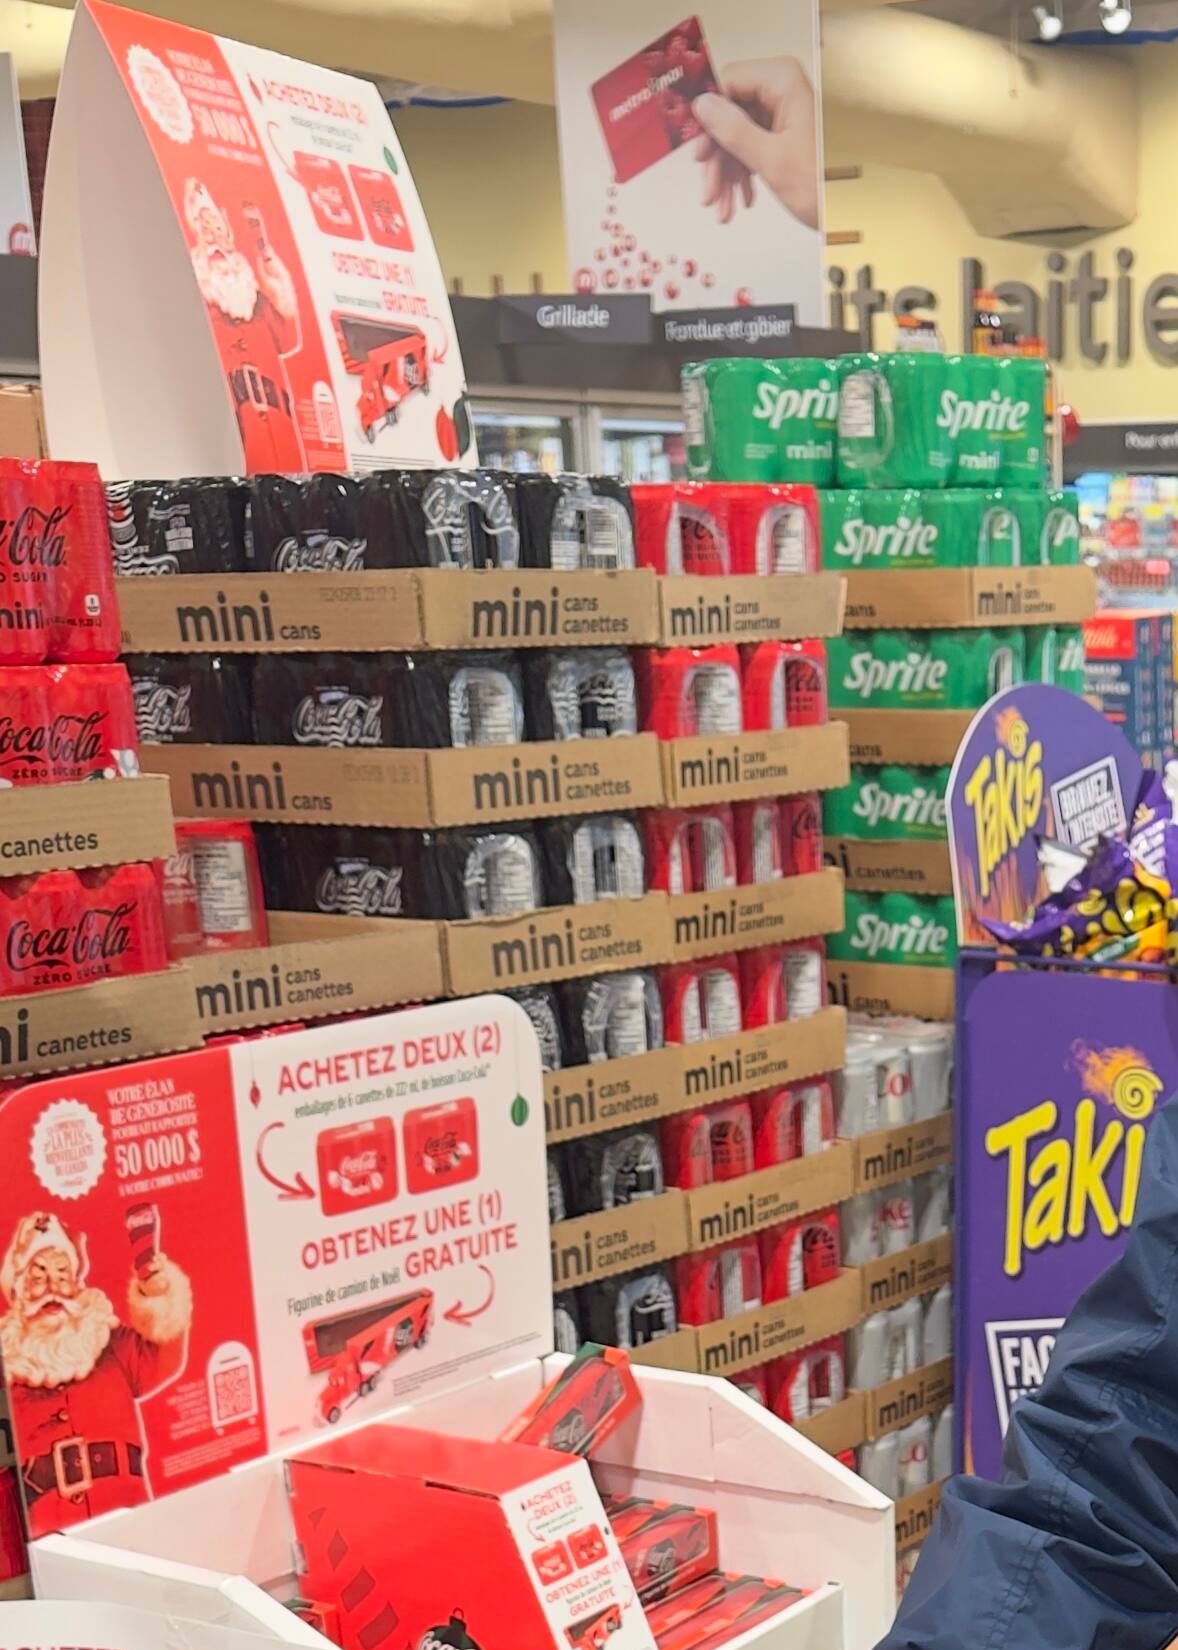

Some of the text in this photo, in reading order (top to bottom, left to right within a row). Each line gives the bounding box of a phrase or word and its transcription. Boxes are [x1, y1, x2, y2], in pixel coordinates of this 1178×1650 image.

[537, 304, 610, 328] Grillade
[752, 379, 839, 429] Sprit
[937, 390, 1030, 438] Sprite
[834, 516, 938, 565] Sprite
[176, 590, 321, 642] mini cans
[472, 586, 598, 637] mini cans
[671, 595, 731, 637] mini
[977, 583, 1022, 616] mini
[563, 614, 628, 635] canettes
[844, 652, 947, 697] Sprite
[191, 760, 332, 811] mini cans
[473, 754, 600, 810] mini cans
[566, 779, 632, 801] canettes
[680, 747, 740, 789] mini
[853, 782, 946, 827] Sprite
[965, 720, 1044, 897] Takis
[0, 832, 99, 859] canettes
[6, 899, 139, 973] Coca-Cola
[675, 901, 736, 945] mini
[850, 913, 949, 957] Sprite
[493, 919, 612, 977] mini cans
[580, 938, 643, 961] canettes
[33, 970, 72, 986] ZÉRO
[195, 964, 321, 1019] mini cans
[286, 981, 355, 1005] canettes
[37, 1027, 132, 1058] canettes
[278, 1022, 501, 1095] ACHETEZ DEUX (2)
[600, 1078, 631, 1098] cans
[685, 1049, 742, 1096] mini
[600, 1093, 659, 1119] canettes
[115, 1141, 143, 1178] 50
[144, 1132, 185, 1172] 000
[187, 1127, 202, 1163] $
[864, 1137, 914, 1181] mini
[985, 1080, 1150, 1278] Taki
[302, 1190, 502, 1270] OBTENEZ UNE (1)
[699, 1195, 755, 1244] mini
[405, 1223, 518, 1279] GRATUITE
[551, 1229, 629, 1281] ini cans
[598, 1240, 656, 1269] canettes
[288, 1267, 401, 1317] Figurine de camion de Noël
[870, 1260, 916, 1304] mini
[705, 1322, 760, 1372] mini
[1000, 1335, 1056, 1386] FAC
[879, 1381, 925, 1428] mini
[526, 1480, 572, 1509] ACHETEZ
[534, 1498, 563, 1520] DEUX
[546, 1566, 609, 1603] OBTENEZ UNE
[569, 1586, 617, 1616] GRATUITE
